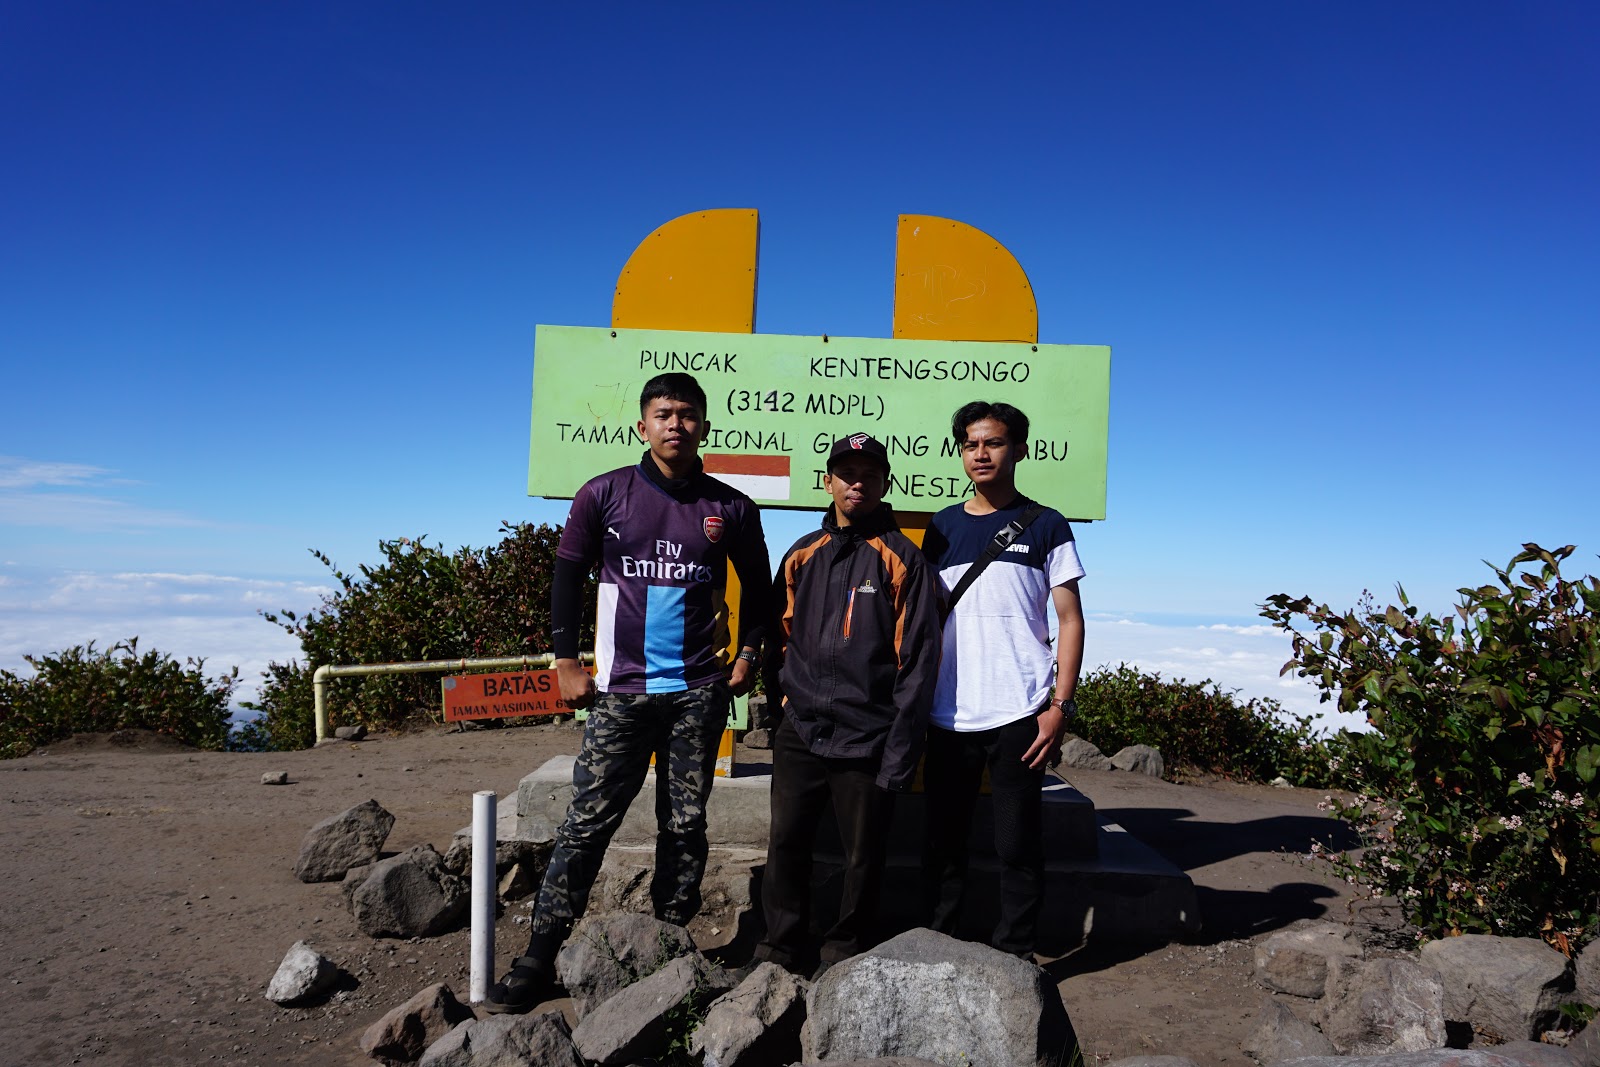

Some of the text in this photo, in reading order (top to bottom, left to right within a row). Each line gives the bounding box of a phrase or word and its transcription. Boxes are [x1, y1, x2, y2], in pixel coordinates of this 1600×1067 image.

[640, 350, 1030, 383] PUNCAK KENTENGSONGO
[727, 389, 885, 421] (3142 MDPL)
[556, 423, 645, 446] TAMAN
[813, 432, 929, 457] GNG
[812, 470, 977, 498] INESIA
[655, 539, 682, 559] Fly
[1005, 543, 1029, 553] EVEN
[621, 555, 712, 583] Emirates
[483, 674, 551, 697] BATAS
[452, 705, 488, 717] TAMAN
[492, 700, 549, 714] NASIONAL
